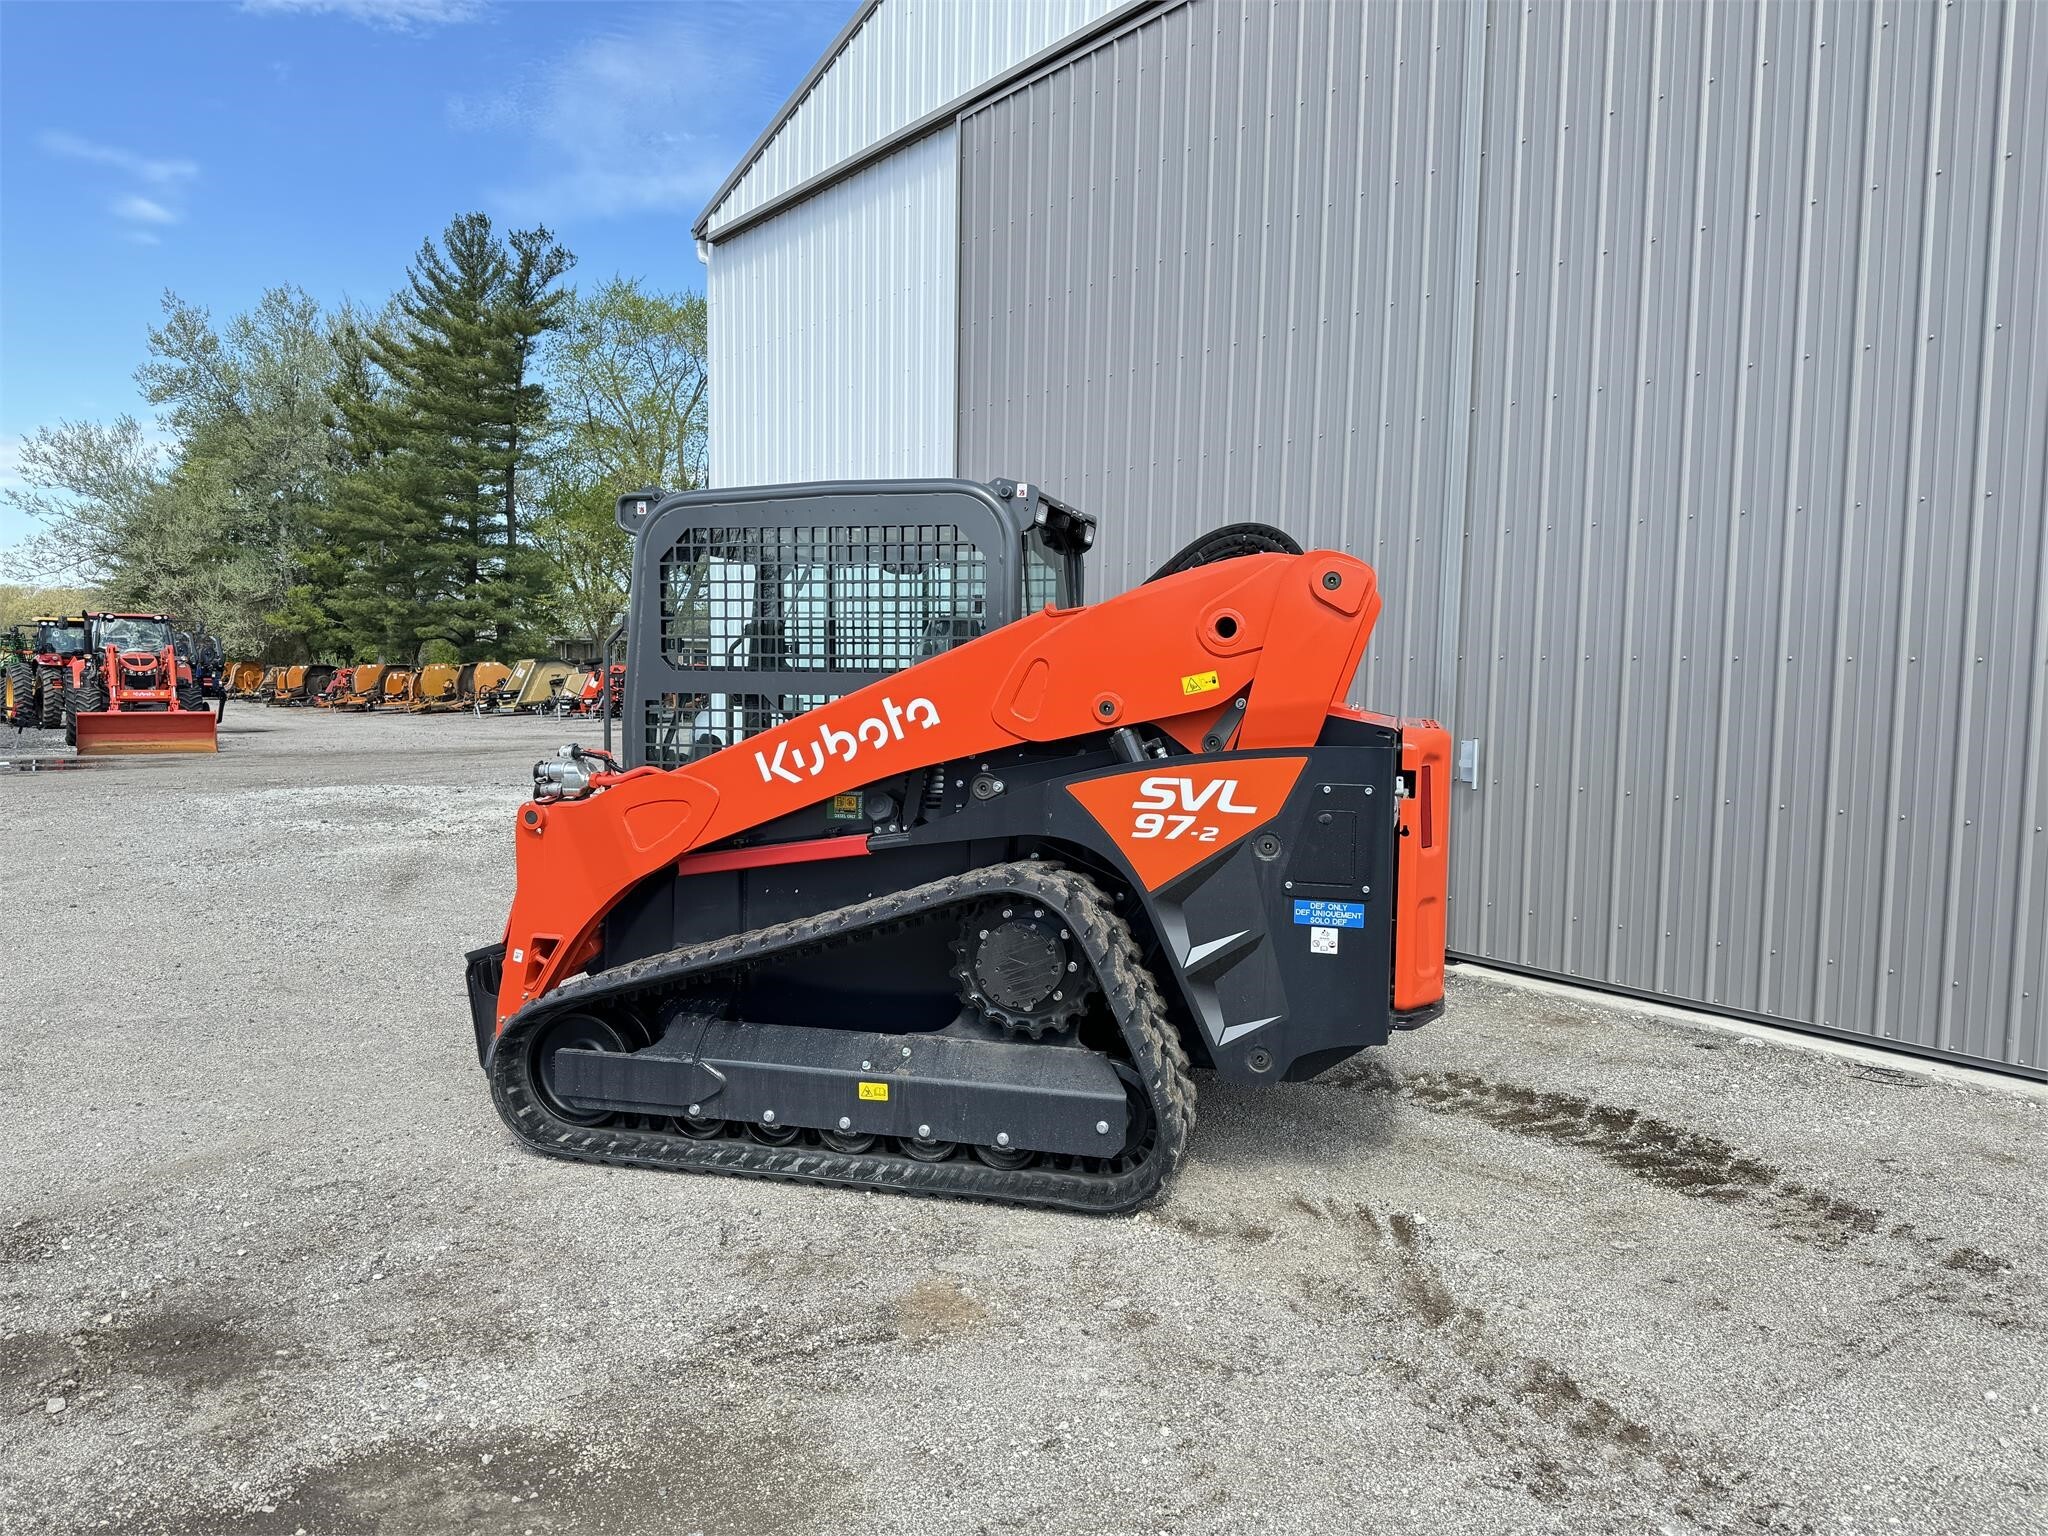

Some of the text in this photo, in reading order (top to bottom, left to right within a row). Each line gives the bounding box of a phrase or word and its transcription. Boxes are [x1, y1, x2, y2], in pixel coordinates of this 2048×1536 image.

[753, 696, 941, 784] Kubota
[1131, 776, 1258, 814] SVL
[1131, 813, 1220, 842] 97-2
[1312, 910, 1362, 919] UNIQUEMENT
